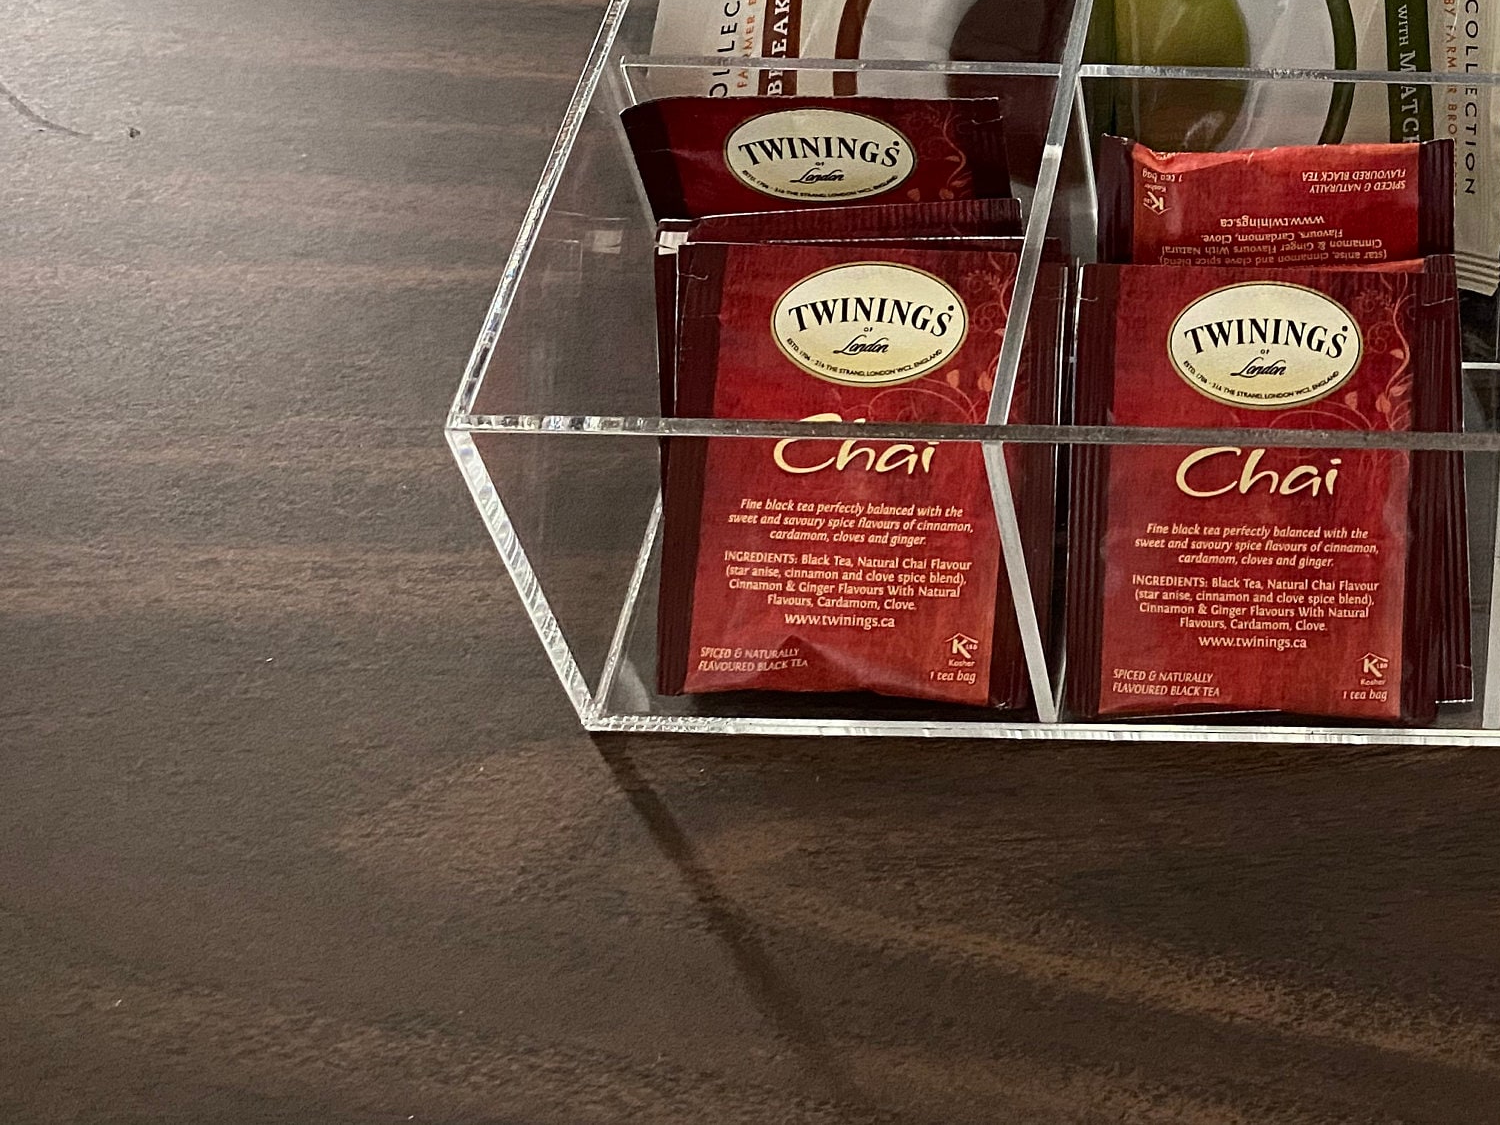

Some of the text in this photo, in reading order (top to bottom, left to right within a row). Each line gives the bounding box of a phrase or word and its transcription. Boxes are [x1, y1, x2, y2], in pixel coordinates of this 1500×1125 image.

[1464, 0, 1478, 194] COLLECTION
[738, 137, 900, 167] TWININGS
[790, 168, 844, 184] London
[1302, 169, 1406, 182] FLAVOURED BLACK TEA
[1309, 182, 1361, 193] NATURALLY
[1375, 180, 1406, 190] SPICED
[1220, 215, 1325, 227] www.twinings.ca
[788, 297, 954, 337] TWININGS
[833, 335, 889, 355] London
[1184, 318, 1348, 358] TWININGS
[1230, 357, 1286, 378] London
[773, 413, 939, 474] Chai
[1175, 446, 1341, 497] Chai
[741, 499, 963, 518] Fine black tea perfectly balanced with the
[1147, 524, 1368, 539] Fine black tea perfectly balanced with the
[1135, 539, 1379, 554] sweet and savoury spice flavours of cinnamon,
[1179, 554, 1334, 569] cardamom, cloves and ginger.
[1133, 575, 1379, 591] INGREDIENTS: Black Tea, Natural Chai Flavour
[1135, 589, 1374, 607] (star anise, cinnamon and clove spice blend),
[1140, 603, 1368, 618] Cinnamon & Ginger Flavours With Natural
[785, 613, 895, 630] www.twinings.ca
[1180, 617, 1327, 631] Flavours, Cardamom, Clove.
[1199, 636, 1306, 651] www.twinings.ca
[1113, 669, 1145, 681] SPICED
[1159, 671, 1213, 683] NATURALLY
[1113, 682, 1220, 697] FLAVOURED BLACK TEA
[1351, 690, 1365, 700] tea
[1370, 689, 1387, 702] bag
